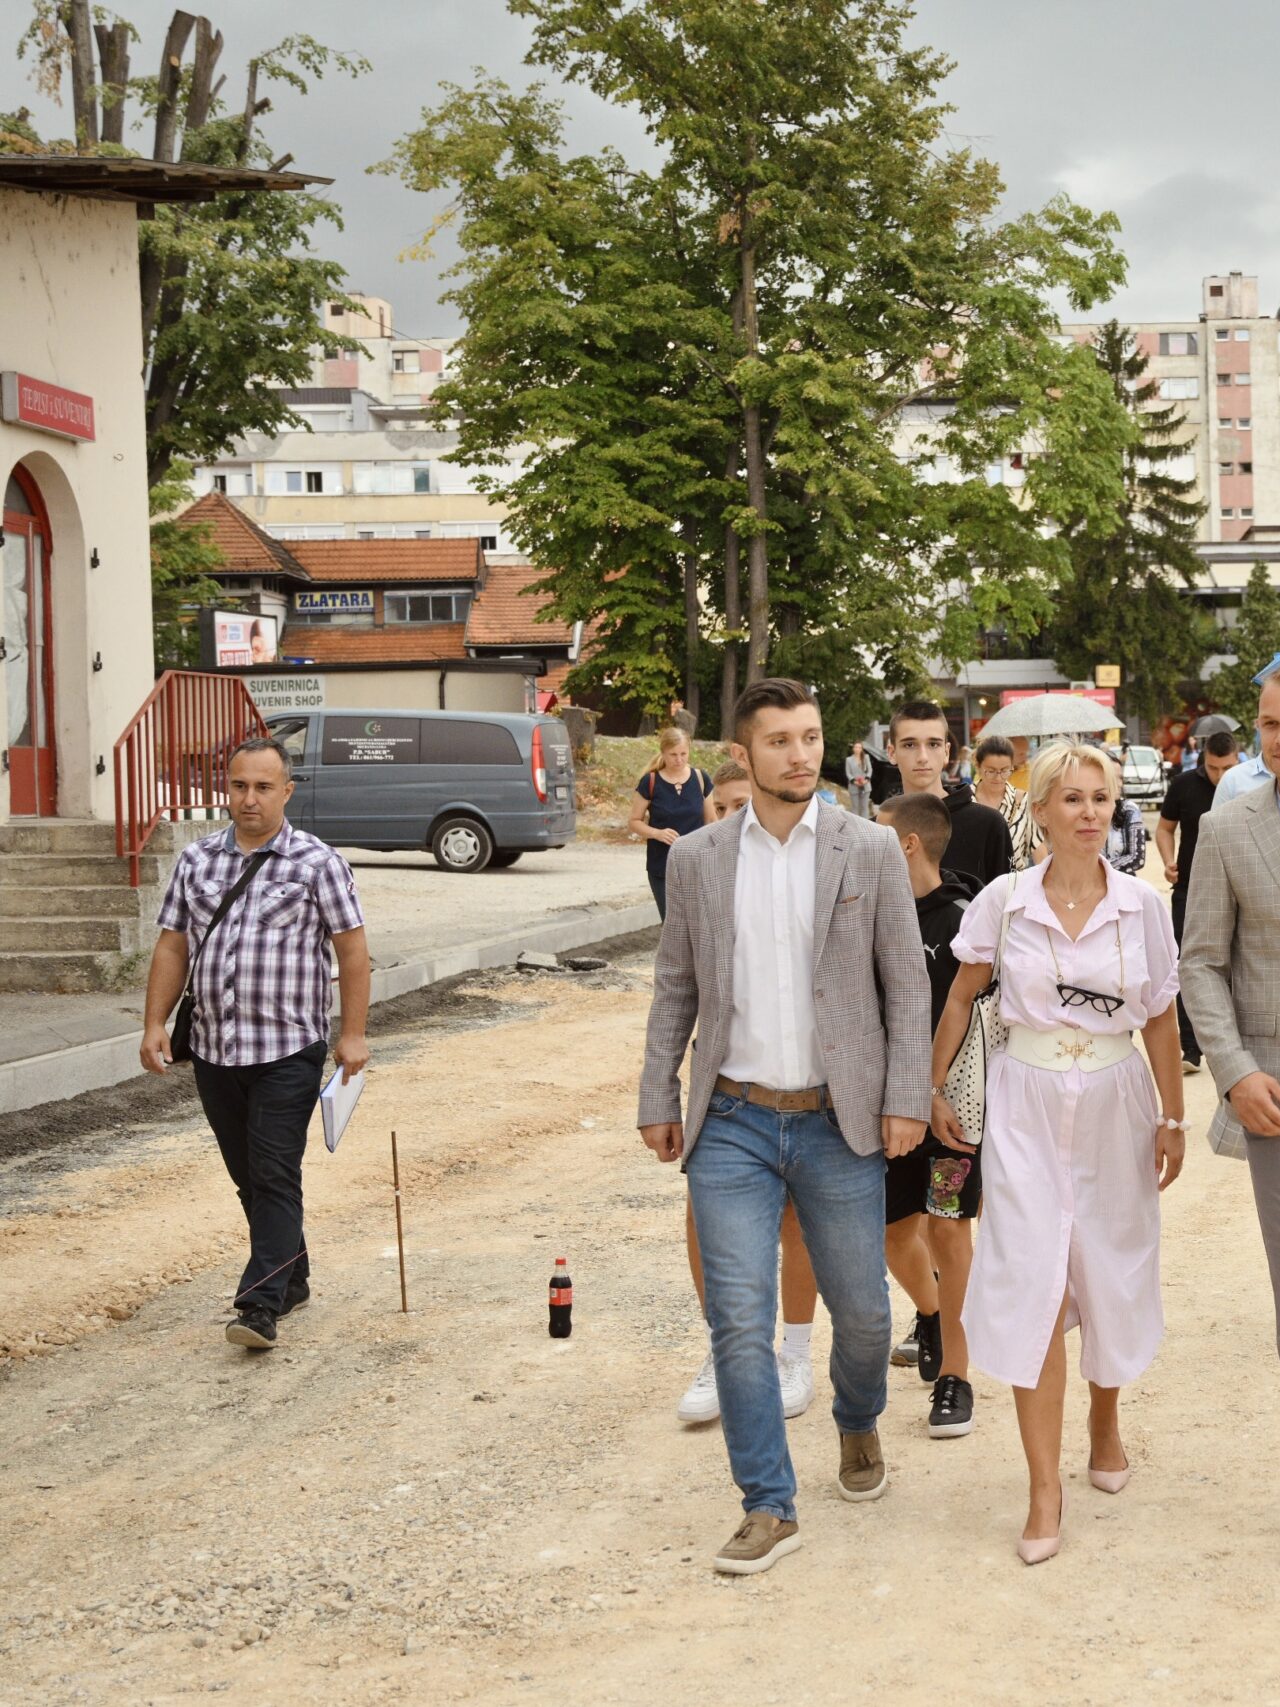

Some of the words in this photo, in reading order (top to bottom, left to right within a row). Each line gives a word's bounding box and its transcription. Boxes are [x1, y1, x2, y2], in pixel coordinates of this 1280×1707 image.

[298, 593, 371, 608] ZLATARA
[250, 679, 320, 693] SUVENIRNICA
[253, 696, 292, 707] UVENIR
[295, 695, 323, 706] SHOP
[925, 1201, 960, 1219] ARROW
